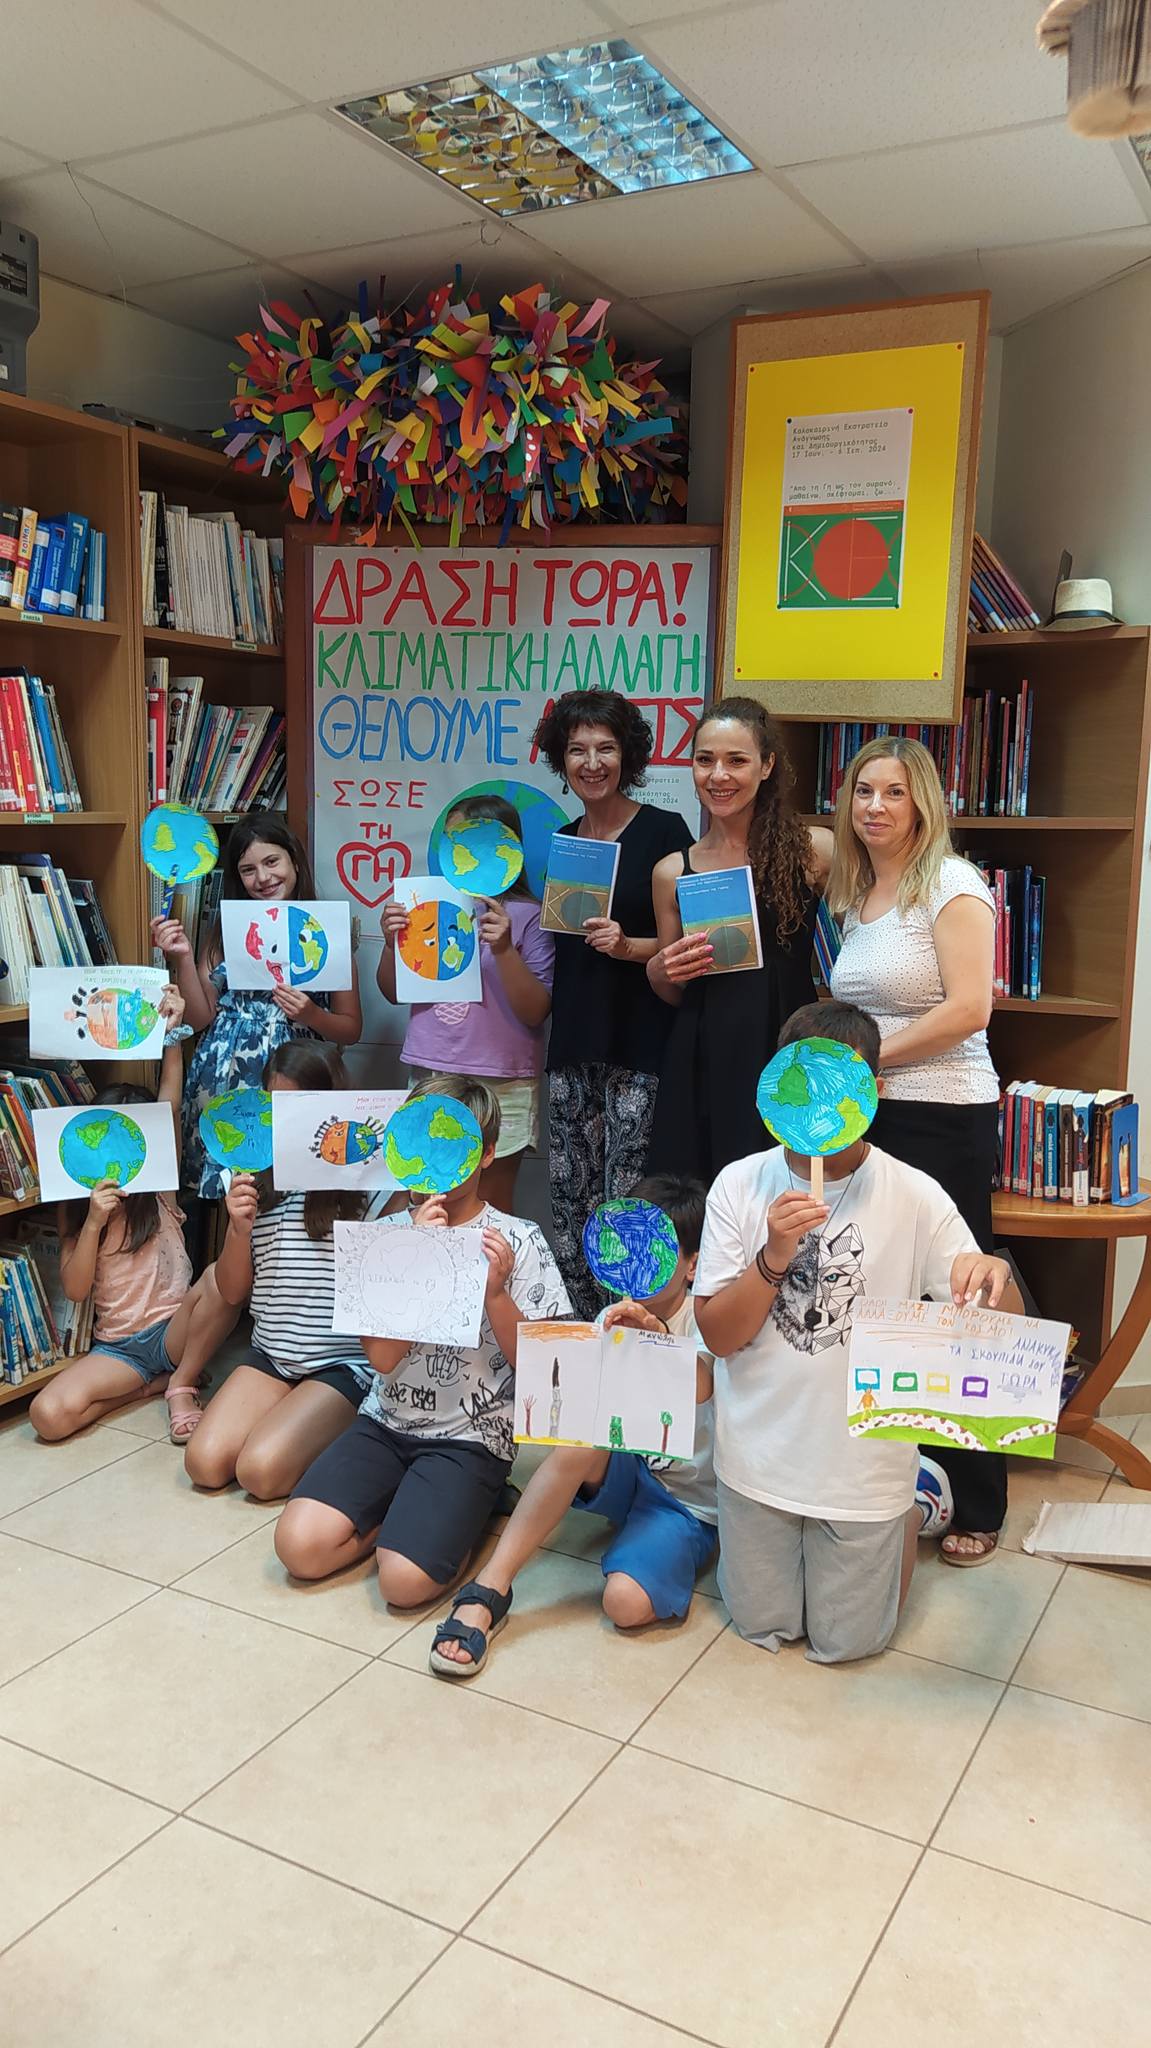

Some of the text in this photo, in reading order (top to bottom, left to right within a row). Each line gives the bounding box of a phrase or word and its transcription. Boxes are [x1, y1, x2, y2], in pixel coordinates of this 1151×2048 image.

[792, 421, 889, 434] Καλοκαιρινή Εκστρατεία
[792, 434, 831, 443] Ανάγνωσης
[808, 438, 878, 450] Δημιουργικότητας
[868, 444, 887, 453] 2024
[822, 483, 832, 491] Γη
[835, 482, 844, 491] ως
[849, 481, 861, 489] τον
[313, 558, 693, 627] ΔΡΑΣΗ ΤΩΡΑ!
[317, 630, 702, 693] ΚΛΙΜΑΤΙΚΗ ΑΛΛΑΓΗ
[318, 694, 522, 765] ΘΕΛΟΥΜΕ
[332, 779, 429, 809] ΣΩΣΕ
[360, 822, 392, 840] ΤΗ
[351, 853, 396, 883] ΓΗ
[937, 1316, 955, 1328] ΤΟΝ
[1023, 1319, 1040, 1329] ΝΑ
